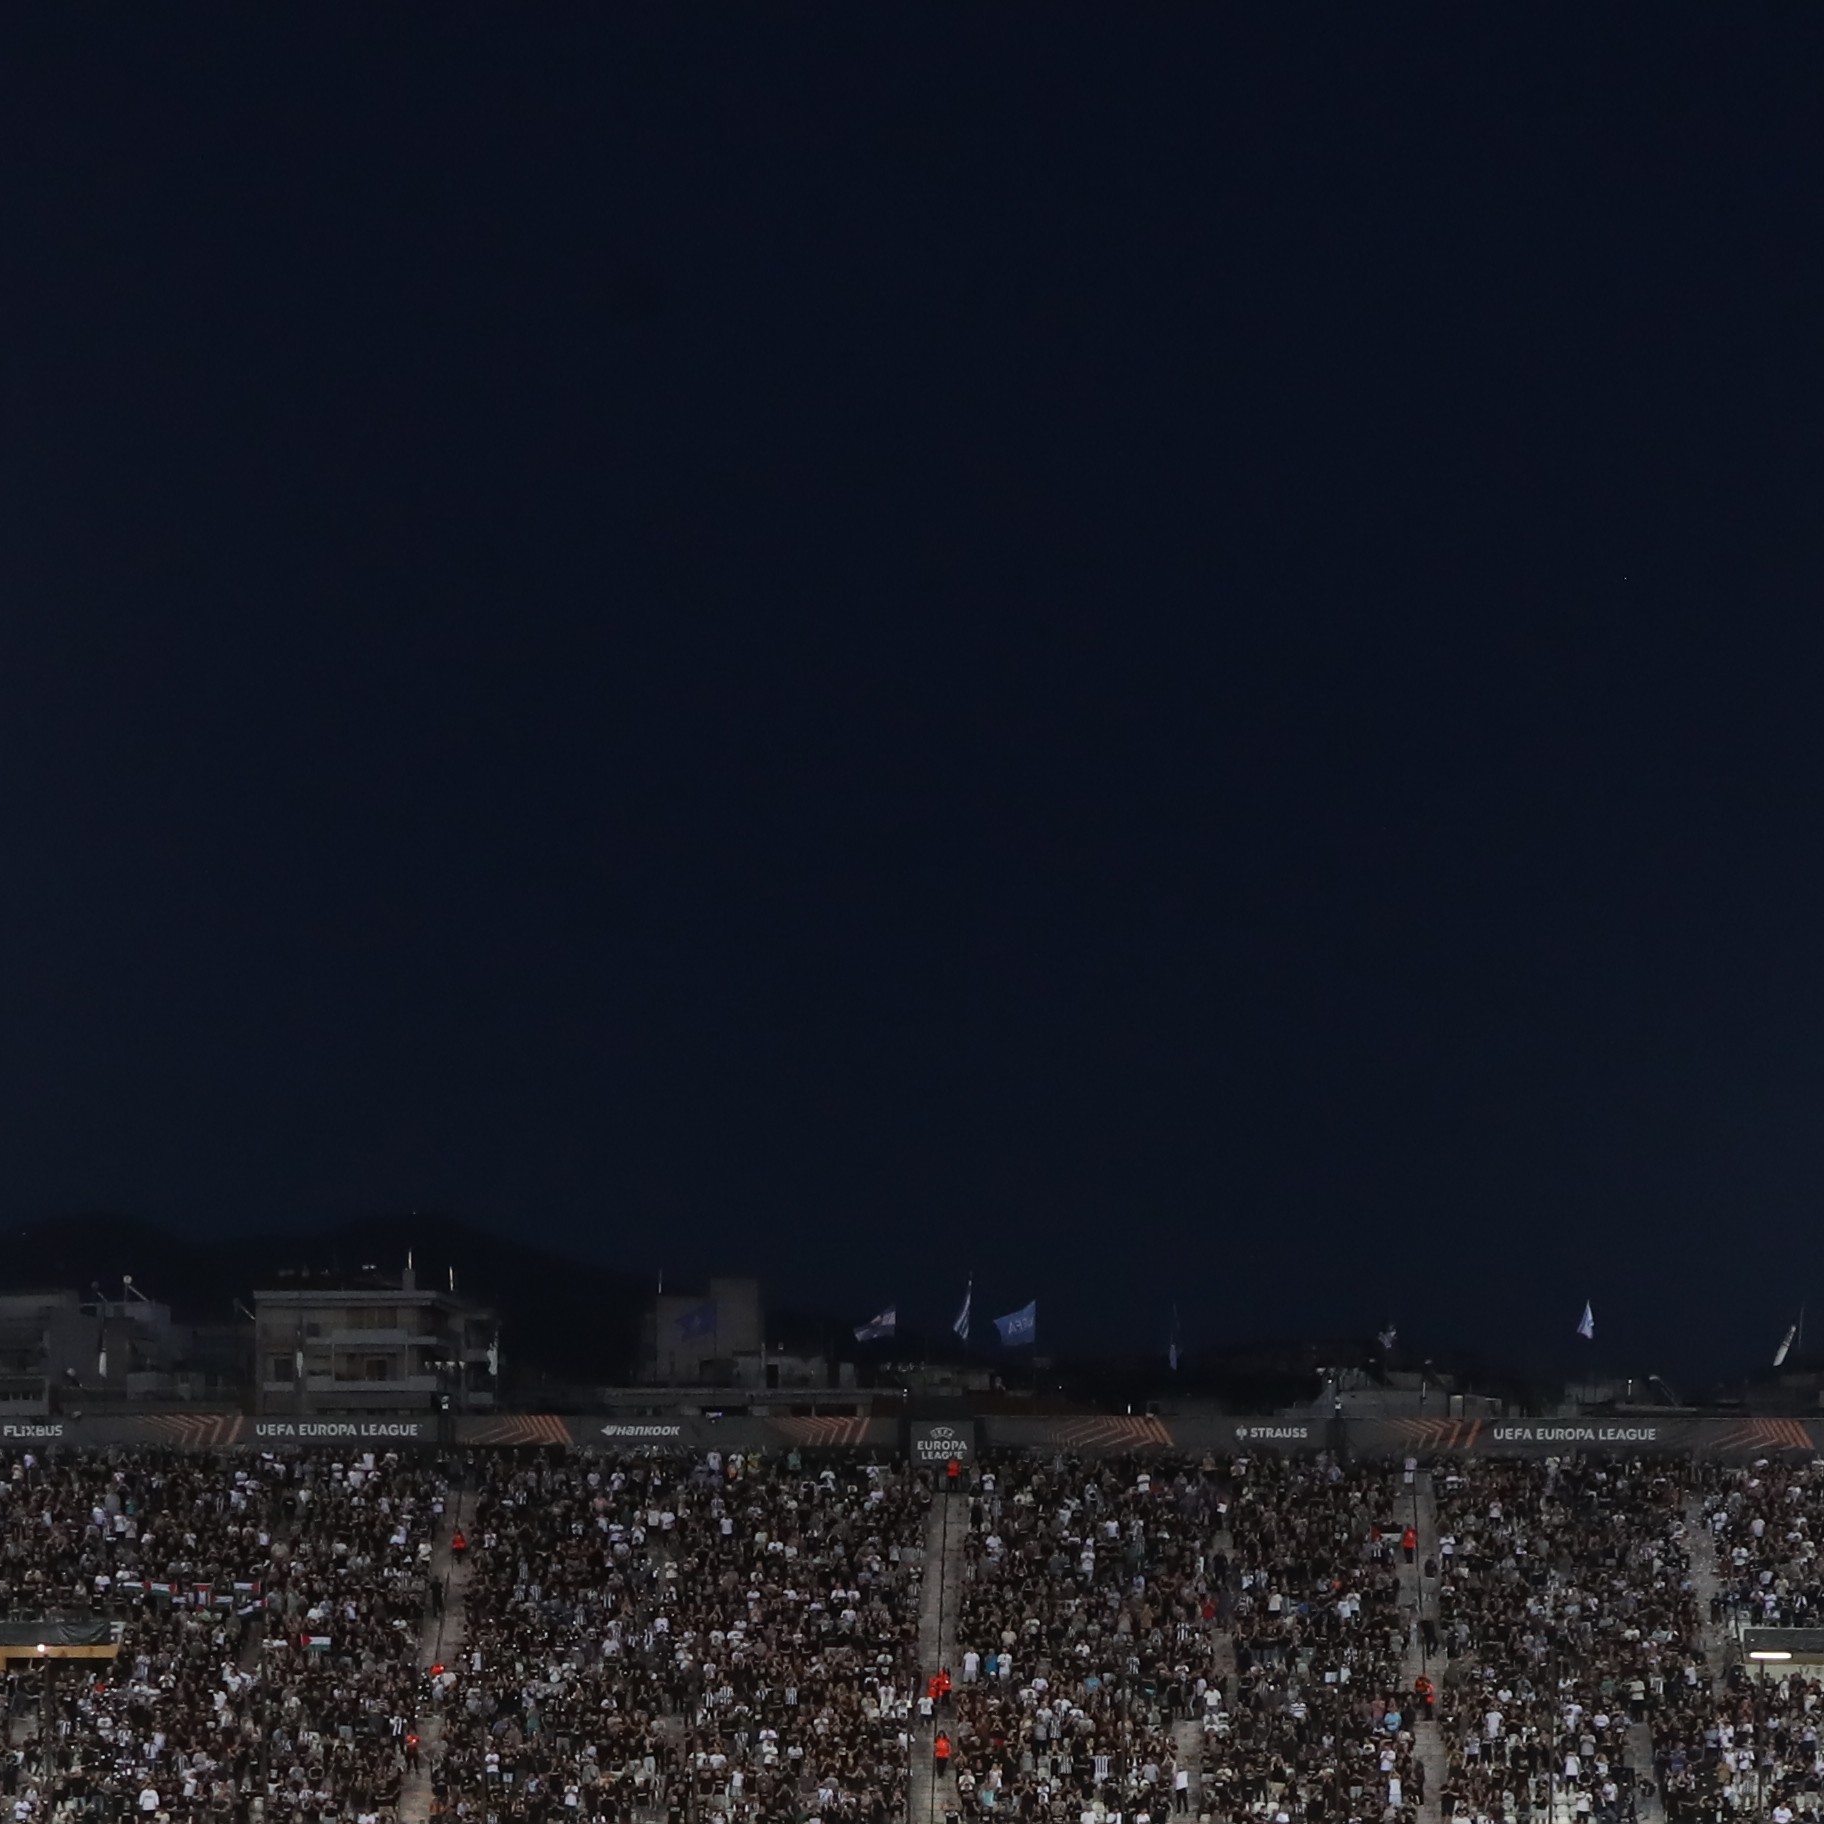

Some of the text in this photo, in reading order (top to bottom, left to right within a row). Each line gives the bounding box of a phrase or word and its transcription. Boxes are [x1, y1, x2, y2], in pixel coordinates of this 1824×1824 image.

[256, 1423, 419, 1436] UEFA EUROPA LEAGUE
[1250, 1427, 1308, 1438] STRAUSS
[1493, 1428, 1656, 1441] UEFA EUROPA LEAGUE
[917, 1440, 967, 1451] EUROPA
